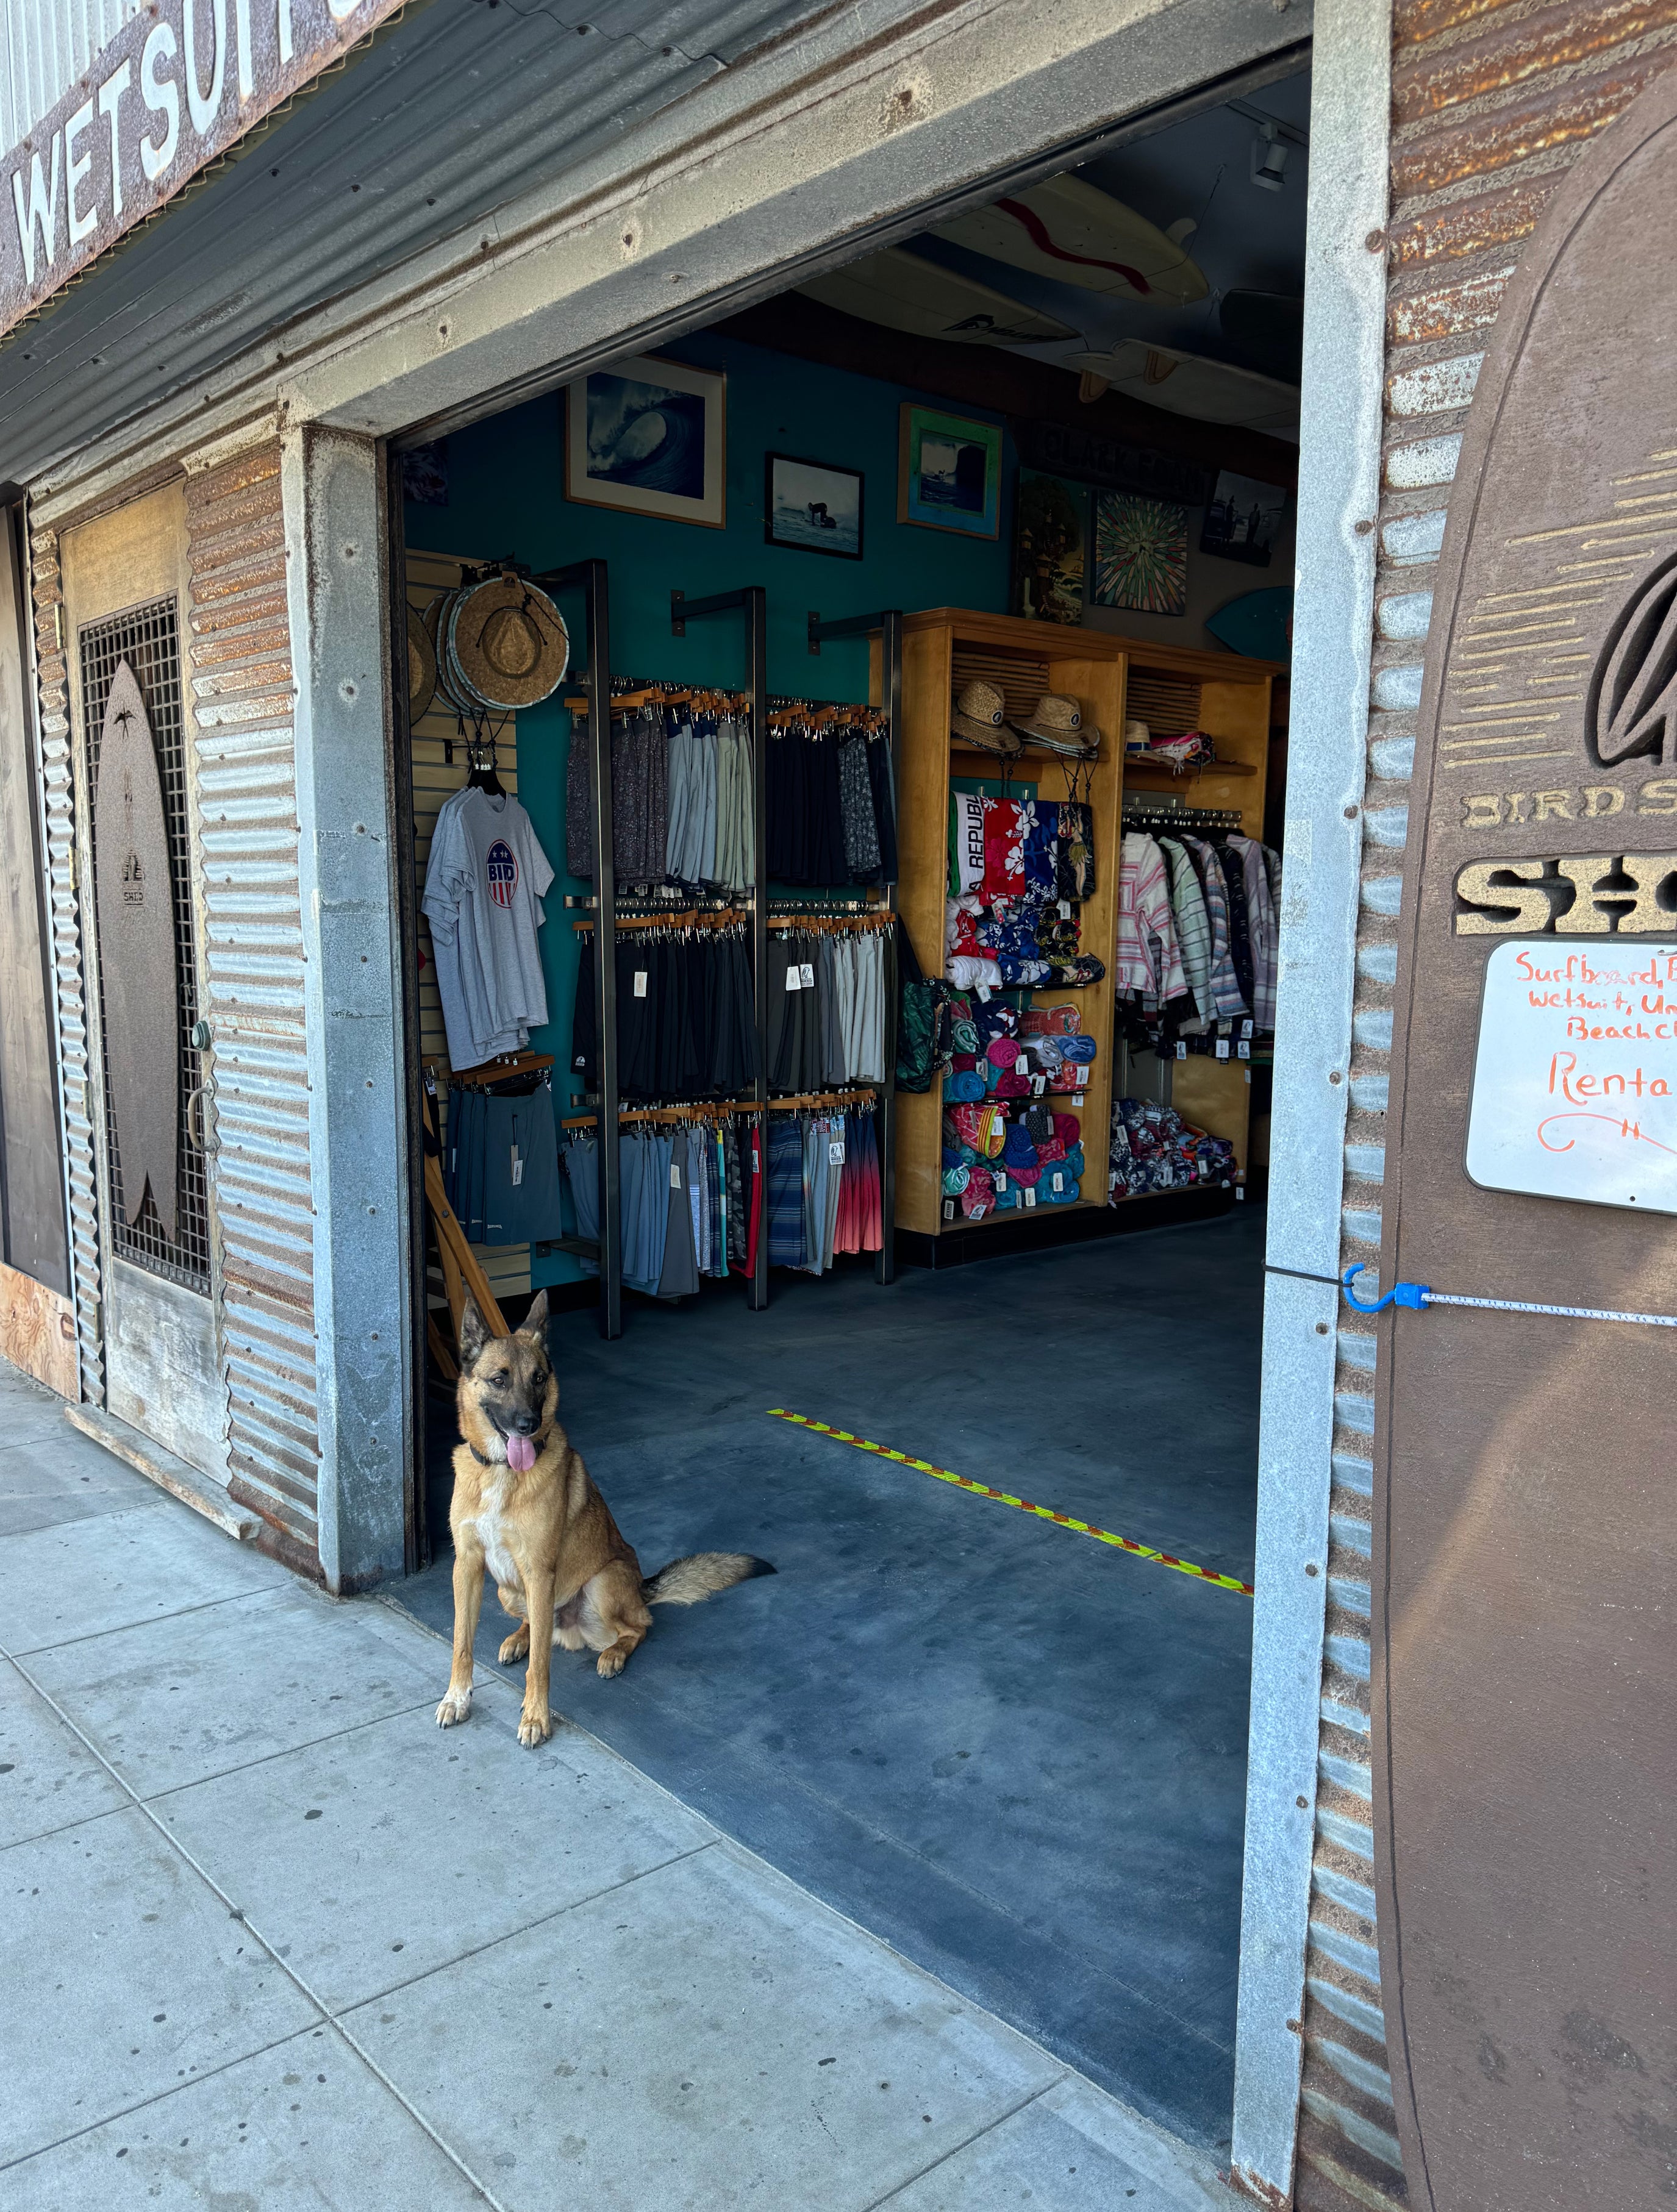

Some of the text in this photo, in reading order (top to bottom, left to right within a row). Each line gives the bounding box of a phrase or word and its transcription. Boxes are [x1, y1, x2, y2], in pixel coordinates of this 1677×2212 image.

[12, 0, 365, 285] WETSUI
[1043, 429, 1129, 477] CLARK
[1567, 1015, 1650, 1041] Beach
[1549, 1051, 1673, 1106] Renta
